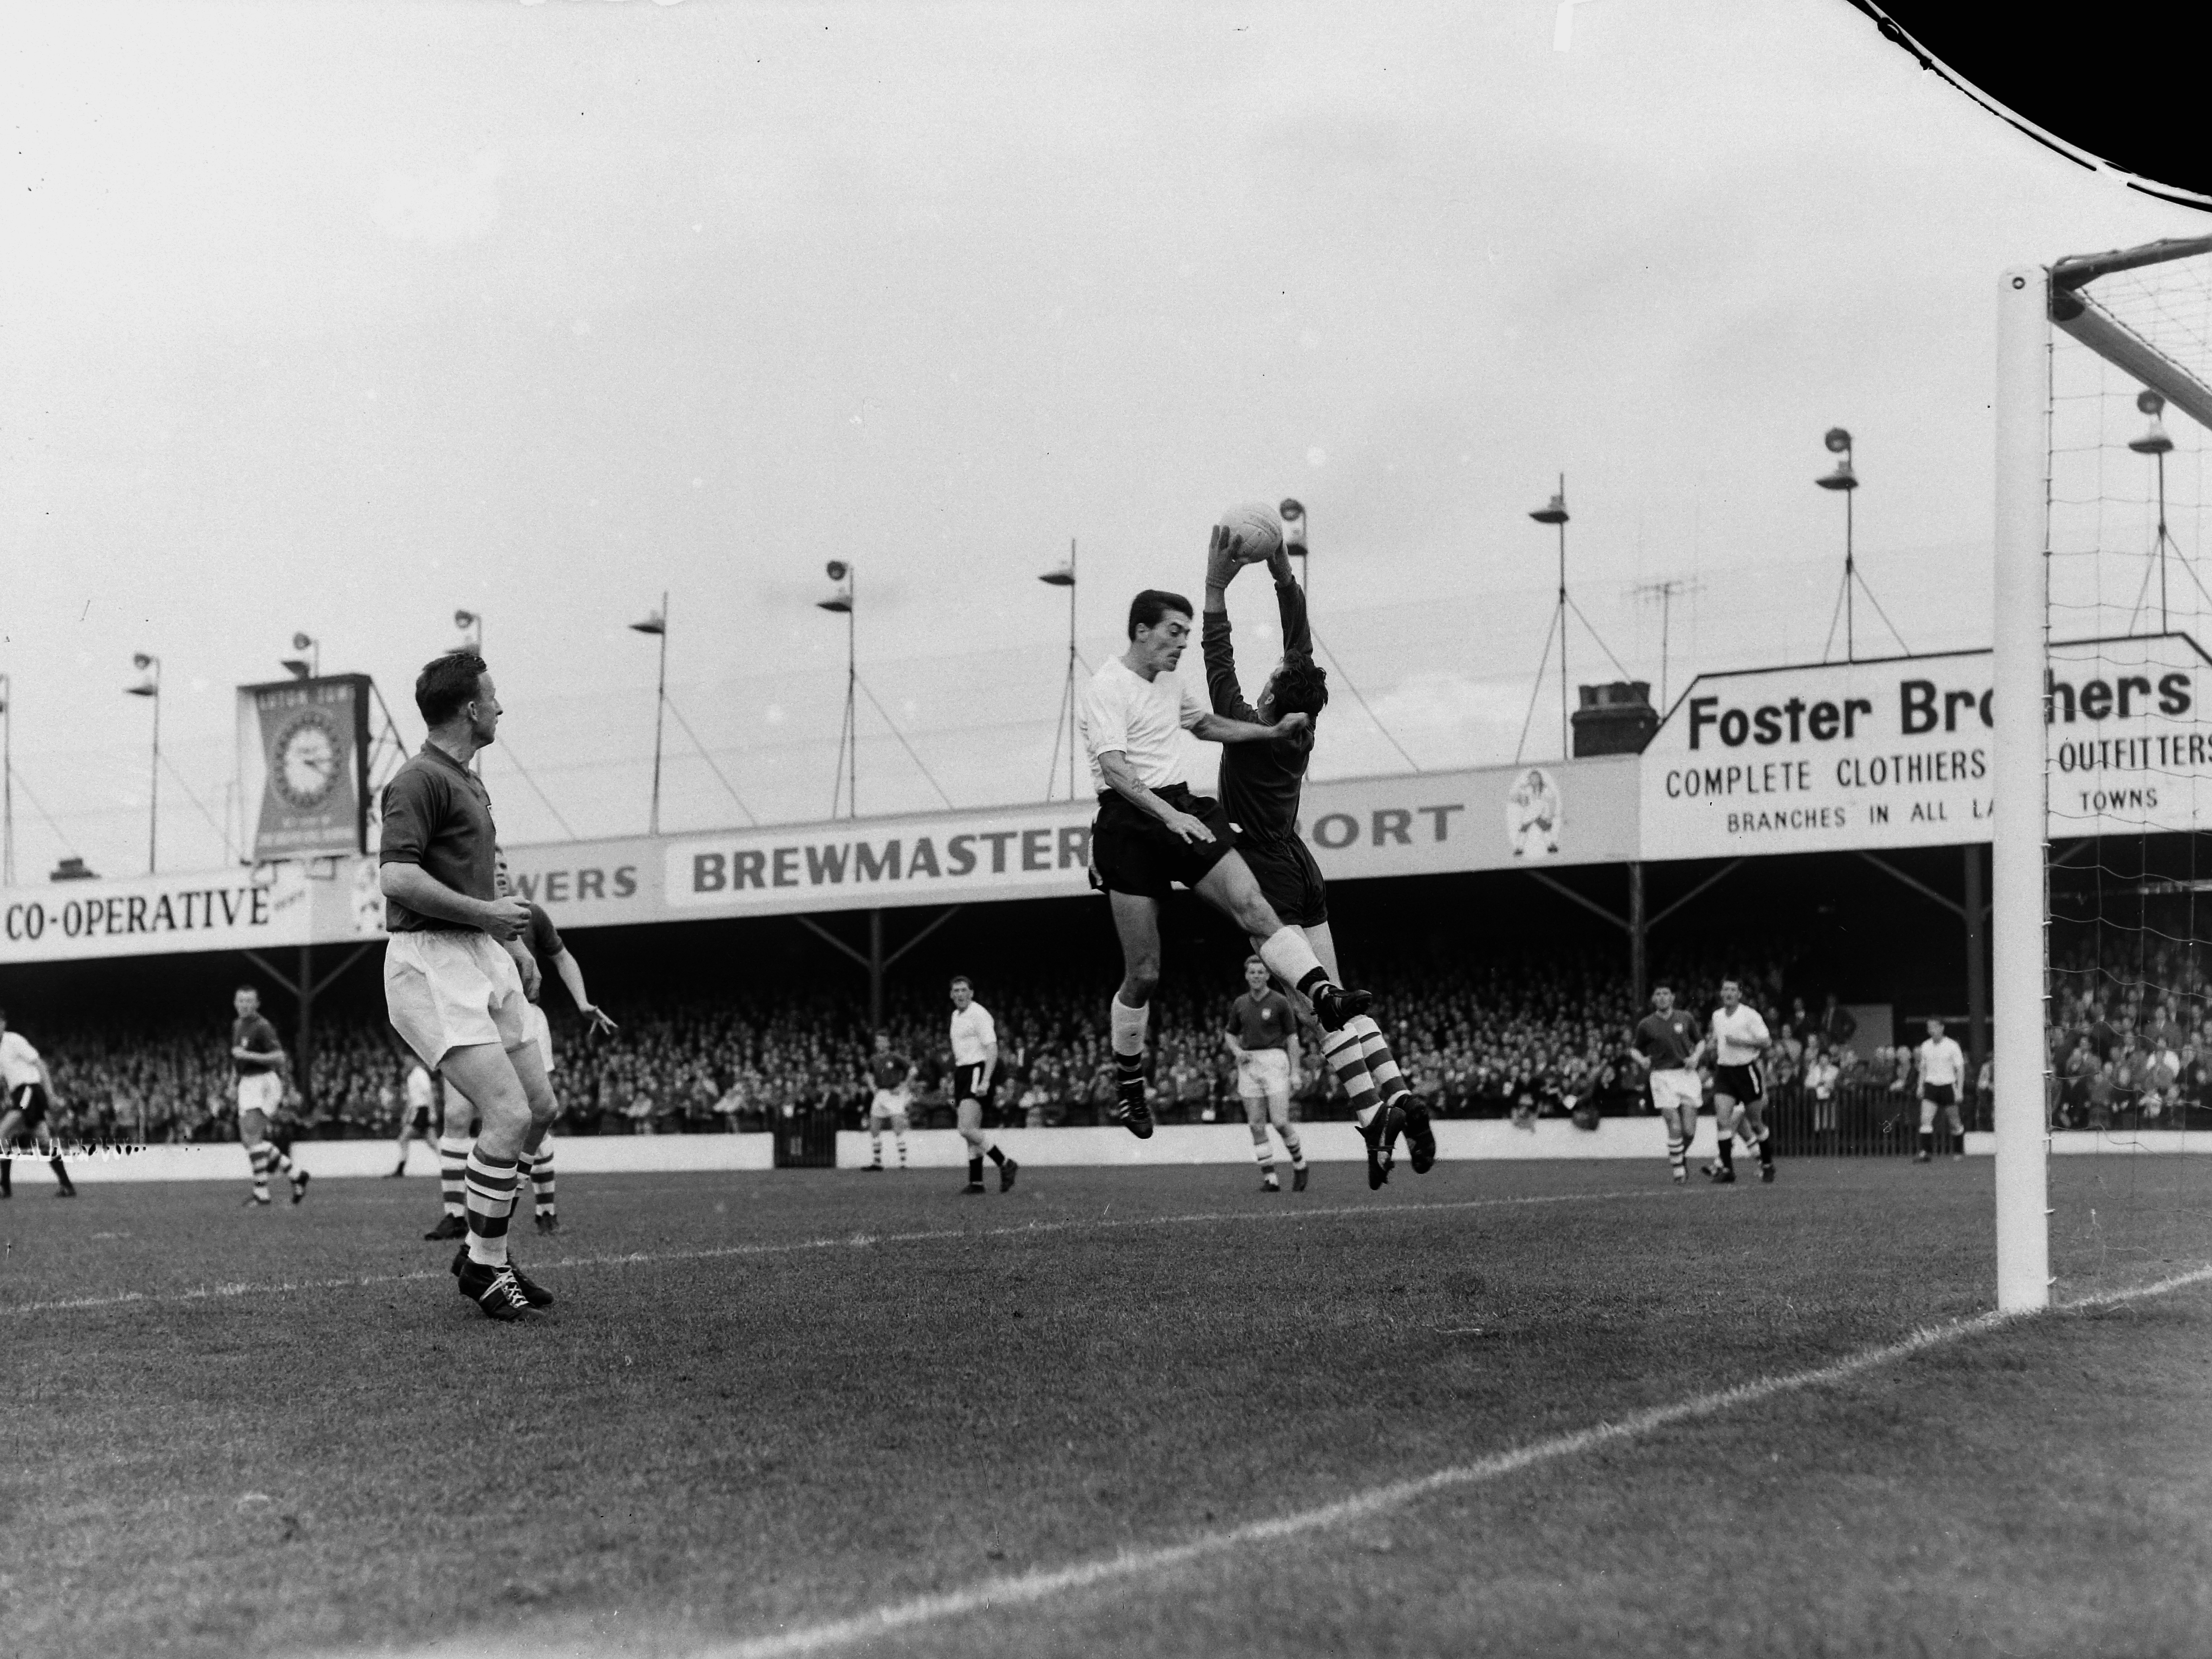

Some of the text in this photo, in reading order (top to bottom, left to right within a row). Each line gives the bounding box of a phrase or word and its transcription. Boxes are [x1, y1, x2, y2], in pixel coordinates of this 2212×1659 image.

[1689, 669, 2191, 750] Foster Brhers
[1666, 759, 1811, 798] COMPLETE
[1836, 748, 1986, 787] CLOTHIERS
[1728, 806, 1846, 833] BRANCHES
[1870, 804, 1889, 824] IN
[1910, 800, 1946, 821] ALL
[2081, 788, 2158, 811] TOWNS
[694, 826, 1091, 892] BREWMASTER
[1295, 804, 1465, 850] ORT
[6, 886, 270, 940] CO-OPERATIVE
